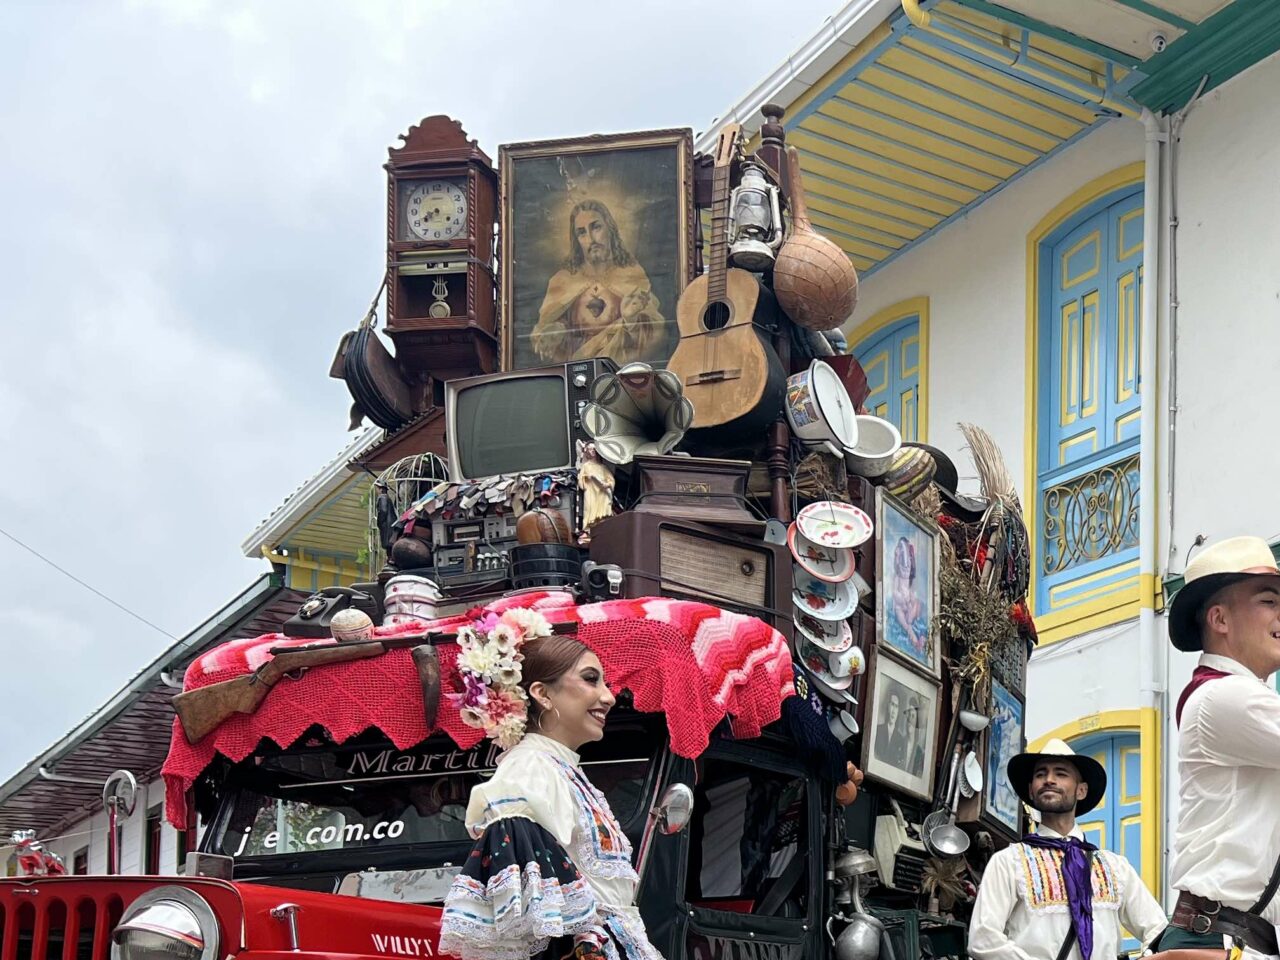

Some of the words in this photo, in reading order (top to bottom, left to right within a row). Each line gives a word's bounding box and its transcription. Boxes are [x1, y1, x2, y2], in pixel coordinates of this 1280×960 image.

[422, 186, 429, 195] 11
[413, 197, 422, 205] 10
[454, 194, 461, 202] 2
[305, 820, 405, 845] com.co
